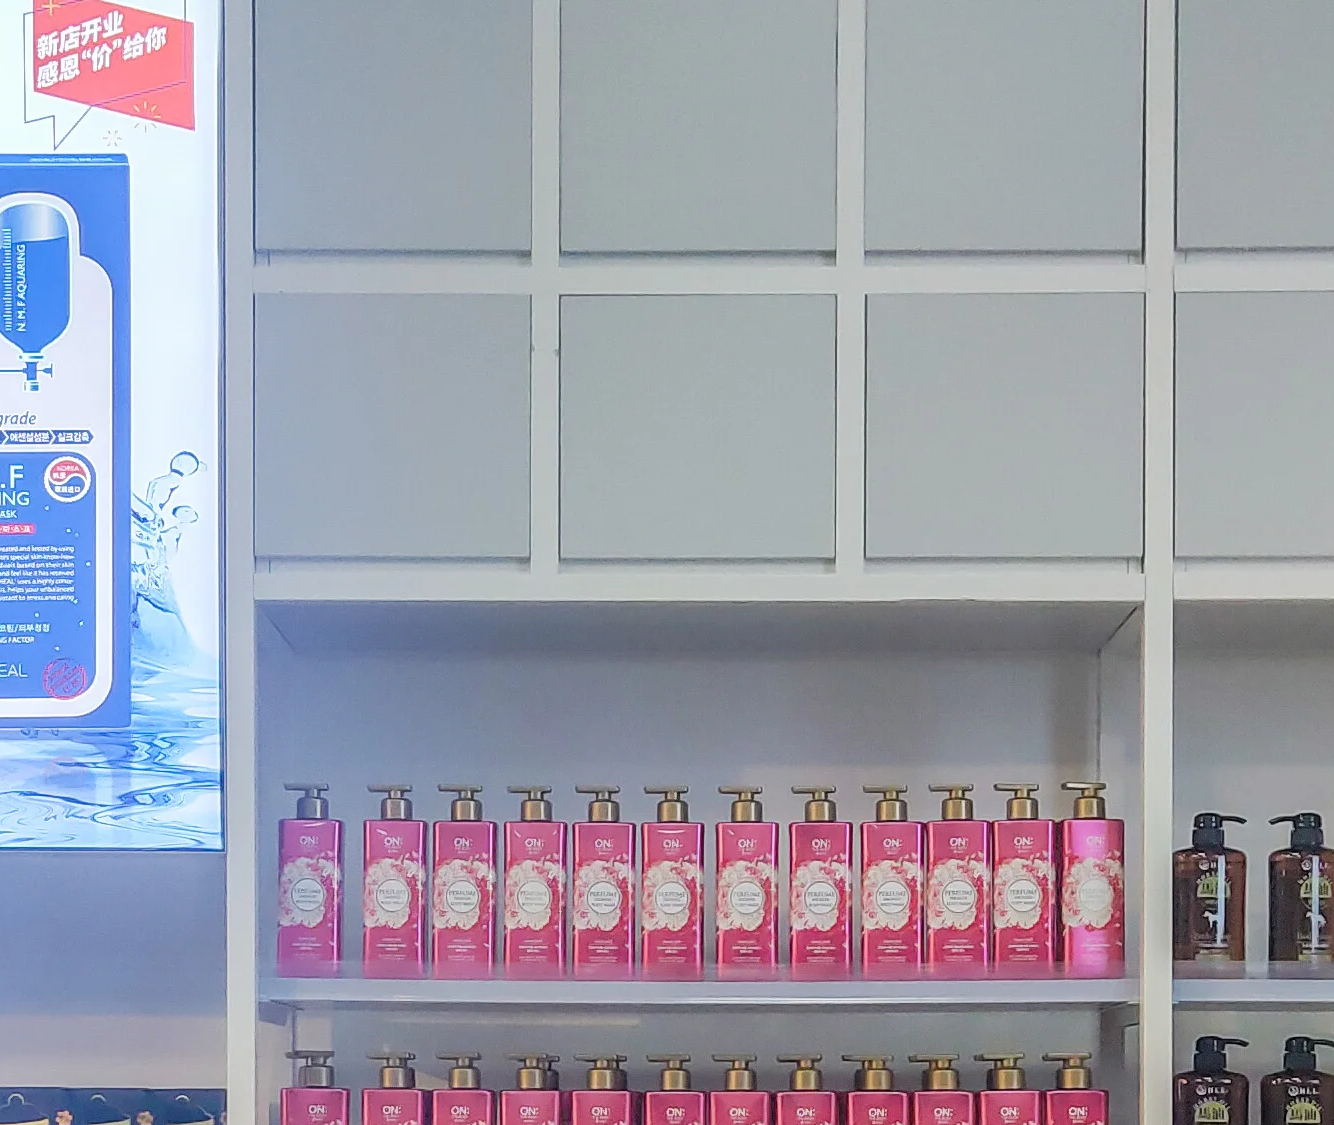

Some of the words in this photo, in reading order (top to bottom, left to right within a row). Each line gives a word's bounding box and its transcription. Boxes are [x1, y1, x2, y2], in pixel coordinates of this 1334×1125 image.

[37, 10, 124, 60] 新店开业
[16, 243, 27, 300] AQUARING
